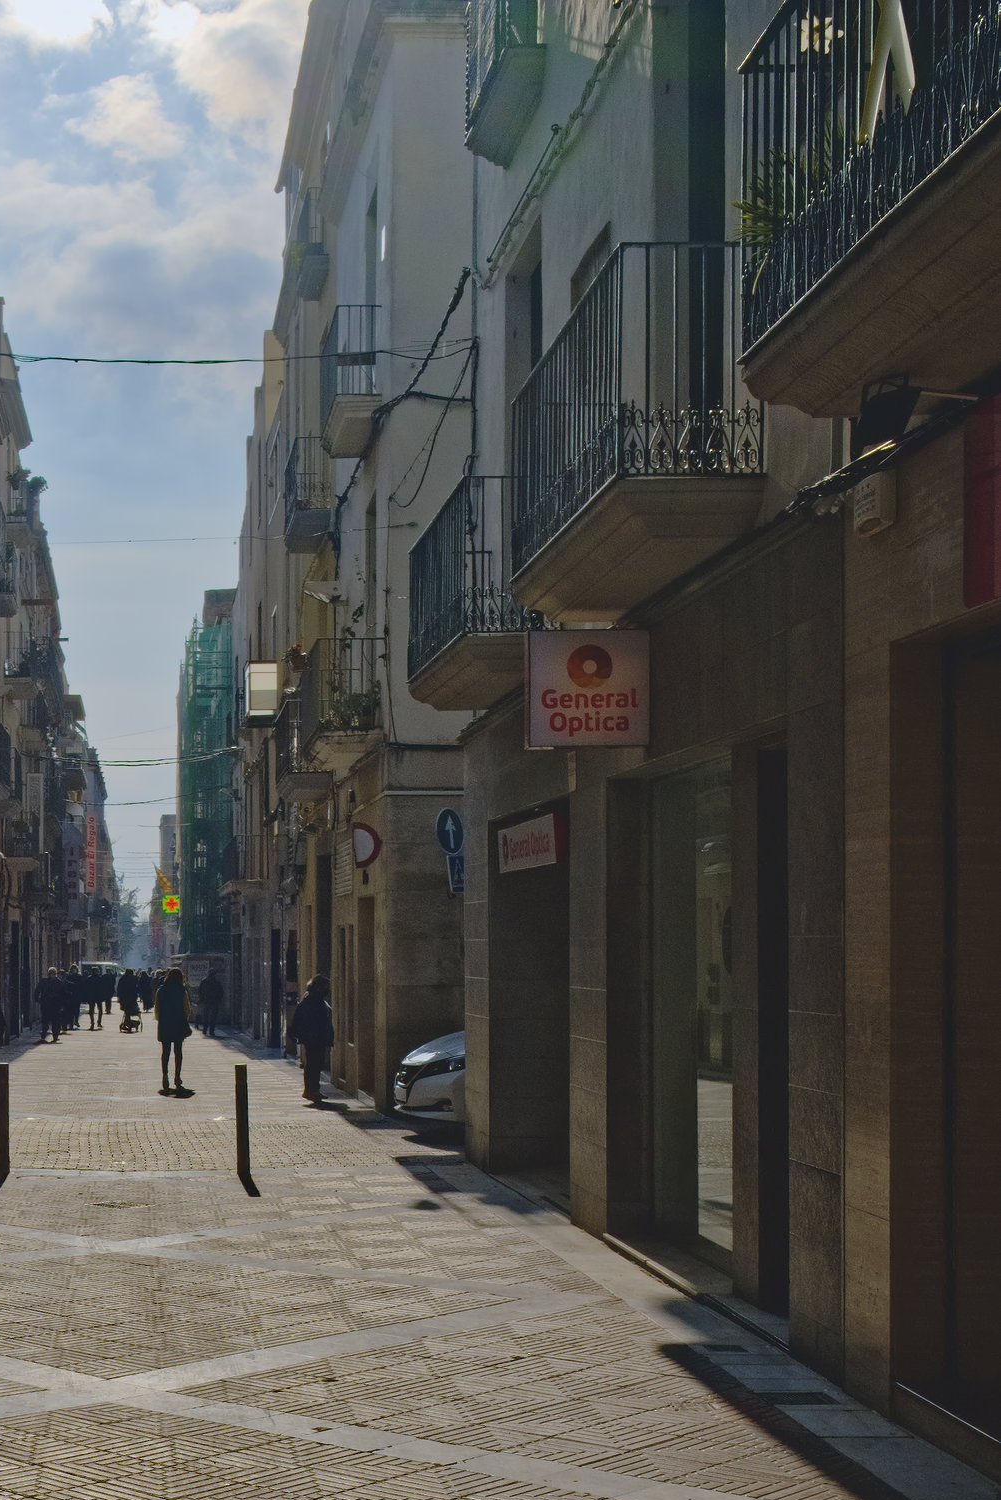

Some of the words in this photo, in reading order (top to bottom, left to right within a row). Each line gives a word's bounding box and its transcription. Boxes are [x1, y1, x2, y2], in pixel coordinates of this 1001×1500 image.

[541, 688, 639, 710] General
[549, 711, 630, 737] Optica
[87, 816, 96, 848] Regalo
[87, 863, 95, 888] Bazar
